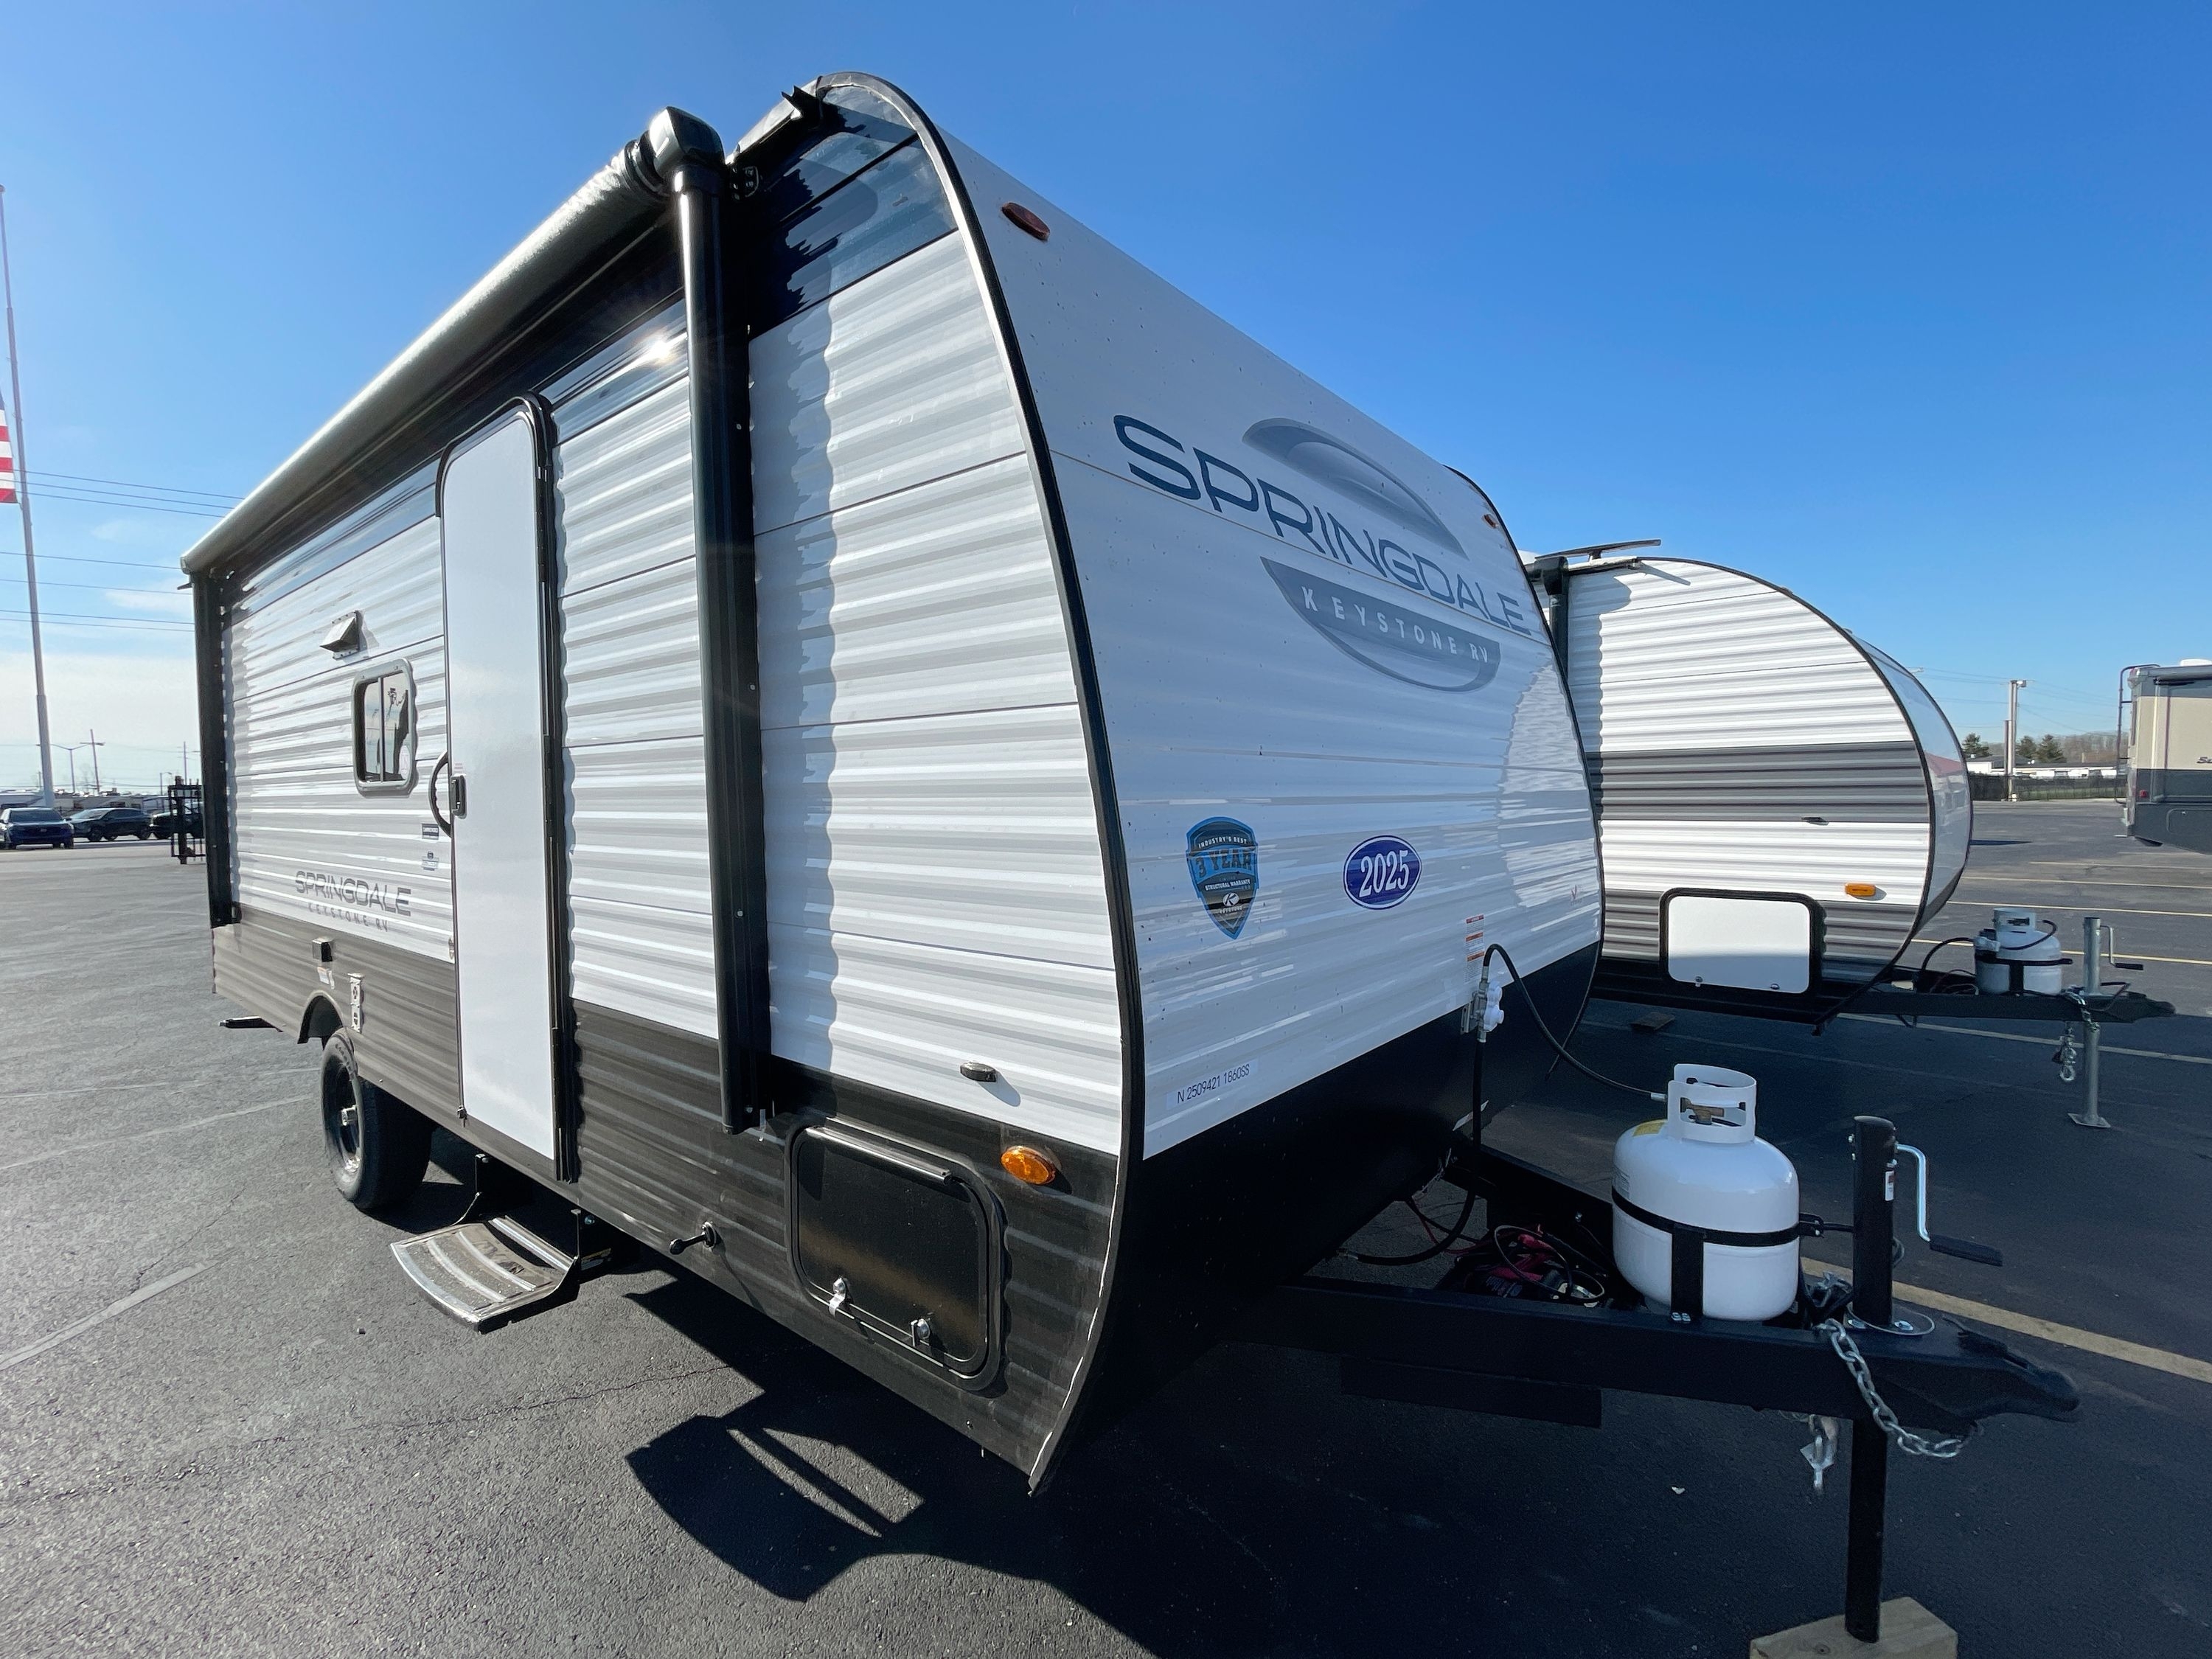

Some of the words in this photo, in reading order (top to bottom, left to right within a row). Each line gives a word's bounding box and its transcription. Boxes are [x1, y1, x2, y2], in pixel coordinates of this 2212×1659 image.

[1113, 414, 1531, 636] SPRINGDALE
[1301, 585, 1457, 655] KEYSTONE
[1469, 642, 1488, 663] RV
[1195, 857, 1207, 877] 3
[1209, 849, 1252, 871] YEAR
[1359, 849, 1410, 898] 2025
[295, 870, 411, 917] SPRINGDALE
[307, 902, 369, 927] KEYSTONE
[375, 917, 389, 933] RV
[1177, 1090, 1185, 1104] N
[1186, 1074, 1221, 1100] 2509421
[1223, 1062, 1251, 1085] 1860SS
